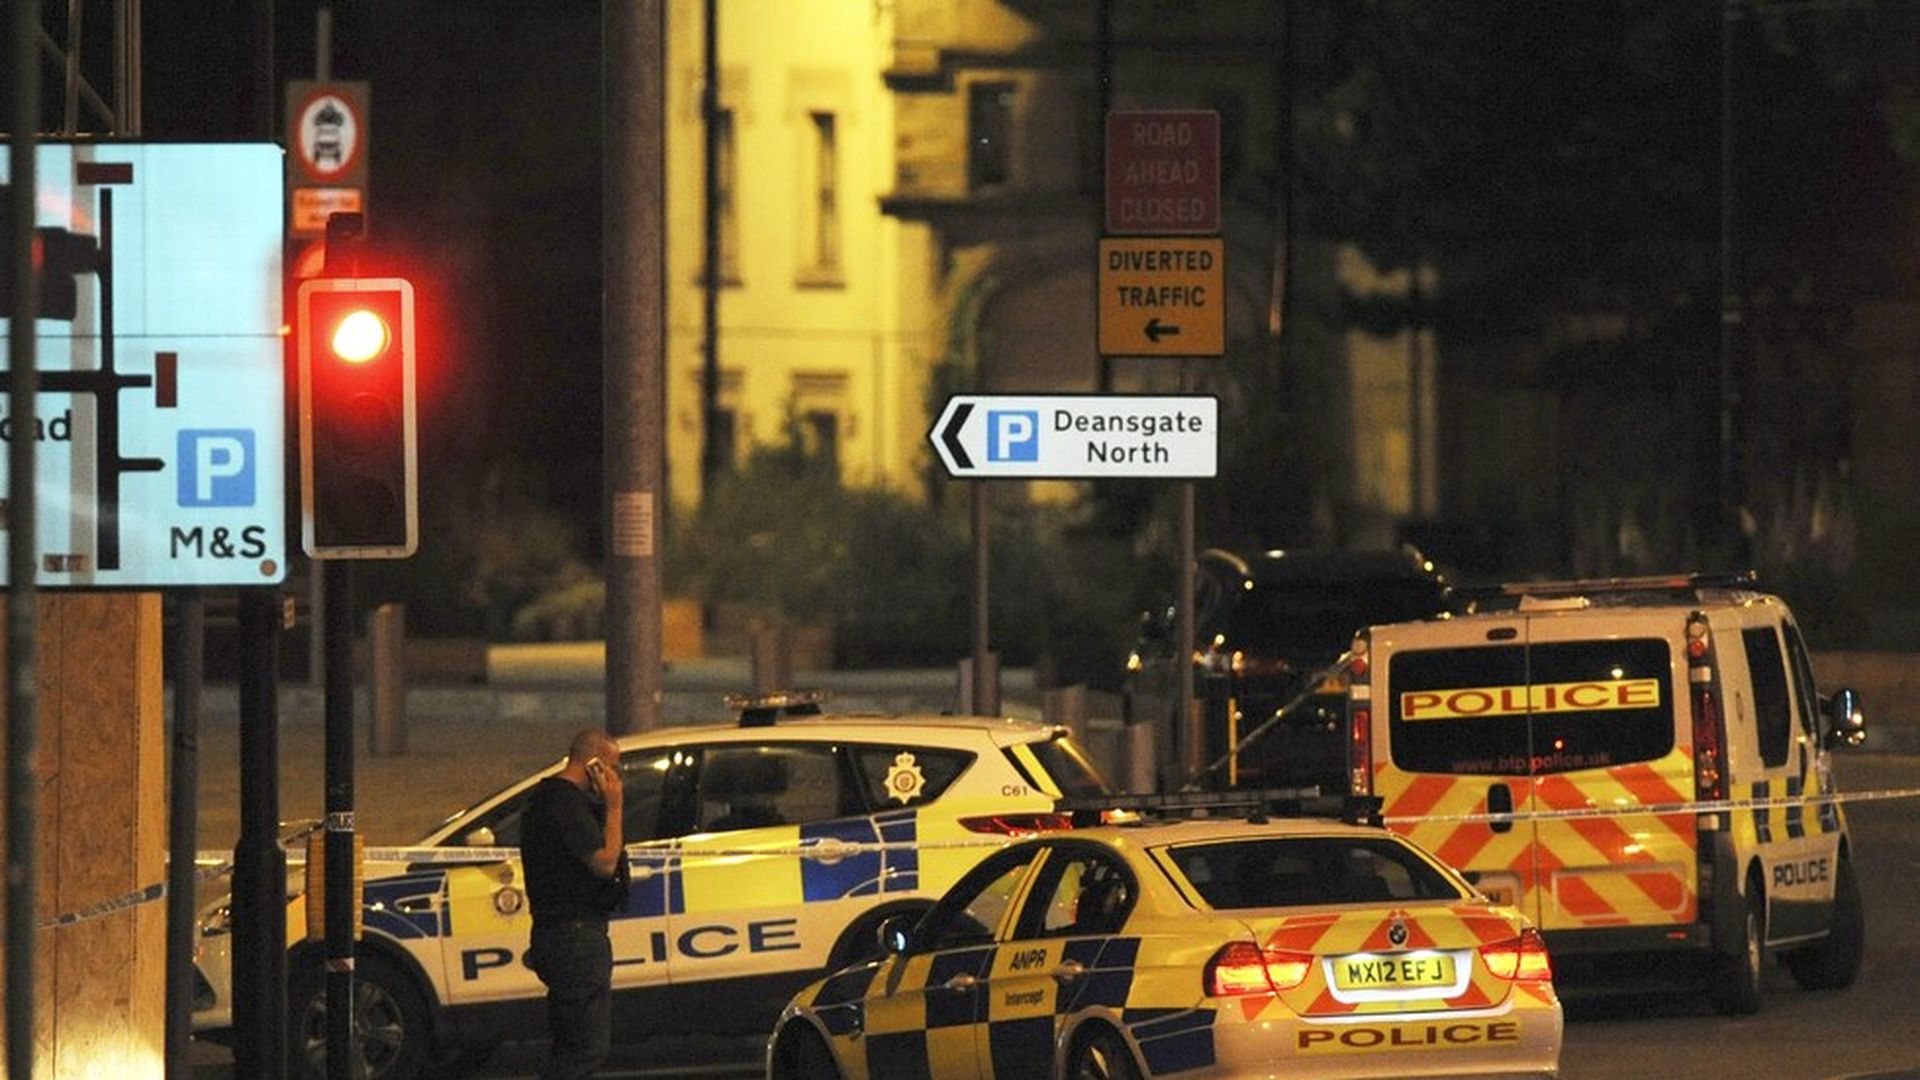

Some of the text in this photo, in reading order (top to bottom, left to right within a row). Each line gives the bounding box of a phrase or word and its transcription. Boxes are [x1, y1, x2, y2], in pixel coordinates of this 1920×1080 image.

[1134, 122, 1191, 146] ROAD
[1126, 161, 1199, 184] AHEAD
[1121, 199, 1205, 222] CLOSED
[1109, 250, 1213, 271] DIVERTED
[1117, 285, 1206, 307] TRAFFIC
[1054, 409, 1203, 436] Deansgate
[1087, 441, 1168, 463] North
[170, 526, 266, 559] M&S
[1404, 681, 1656, 717] POLICE
[1001, 785, 1029, 797] C61
[1773, 858, 1828, 888] POLICE
[1009, 950, 1048, 971] ANPR
[1347, 961, 1398, 983] MX12
[1298, 1022, 1519, 1049] POLICE
